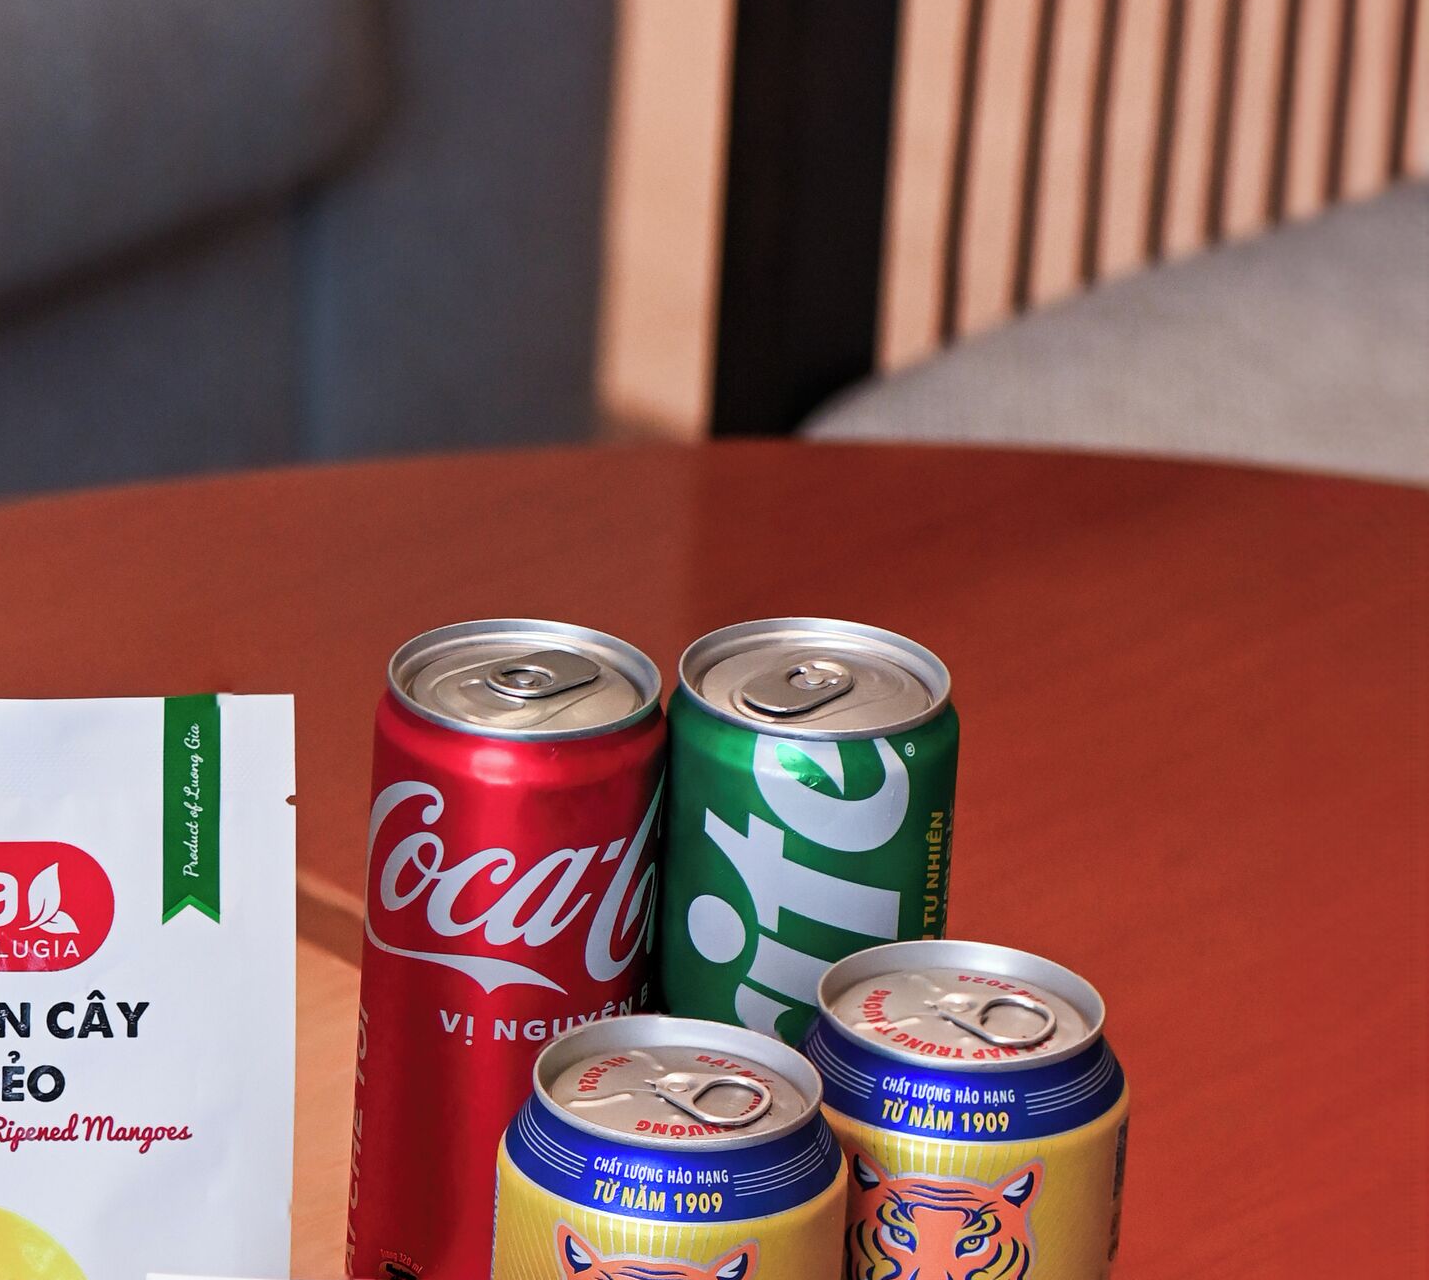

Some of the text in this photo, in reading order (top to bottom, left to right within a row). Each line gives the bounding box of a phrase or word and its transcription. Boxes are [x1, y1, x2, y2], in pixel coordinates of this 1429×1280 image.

[182, 723, 204, 877] Product of Luong Gia
[926, 811, 944, 889] NHIÊN
[45, 991, 150, 1039] CÂY
[439, 1009, 475, 1047] VỊ
[577, 1066, 609, 1093] 2024
[883, 1076, 1016, 1108] CHẤT LƯỢNG HẢO HẠNG
[82, 1113, 193, 1154] Mangoes
[881, 1098, 1010, 1133] TỪ NĂM 1909
[594, 1156, 729, 1188] CHẤT LƯỢNG HẢO HẠNG
[593, 1177, 723, 1214] TỪ NĂM 1909
